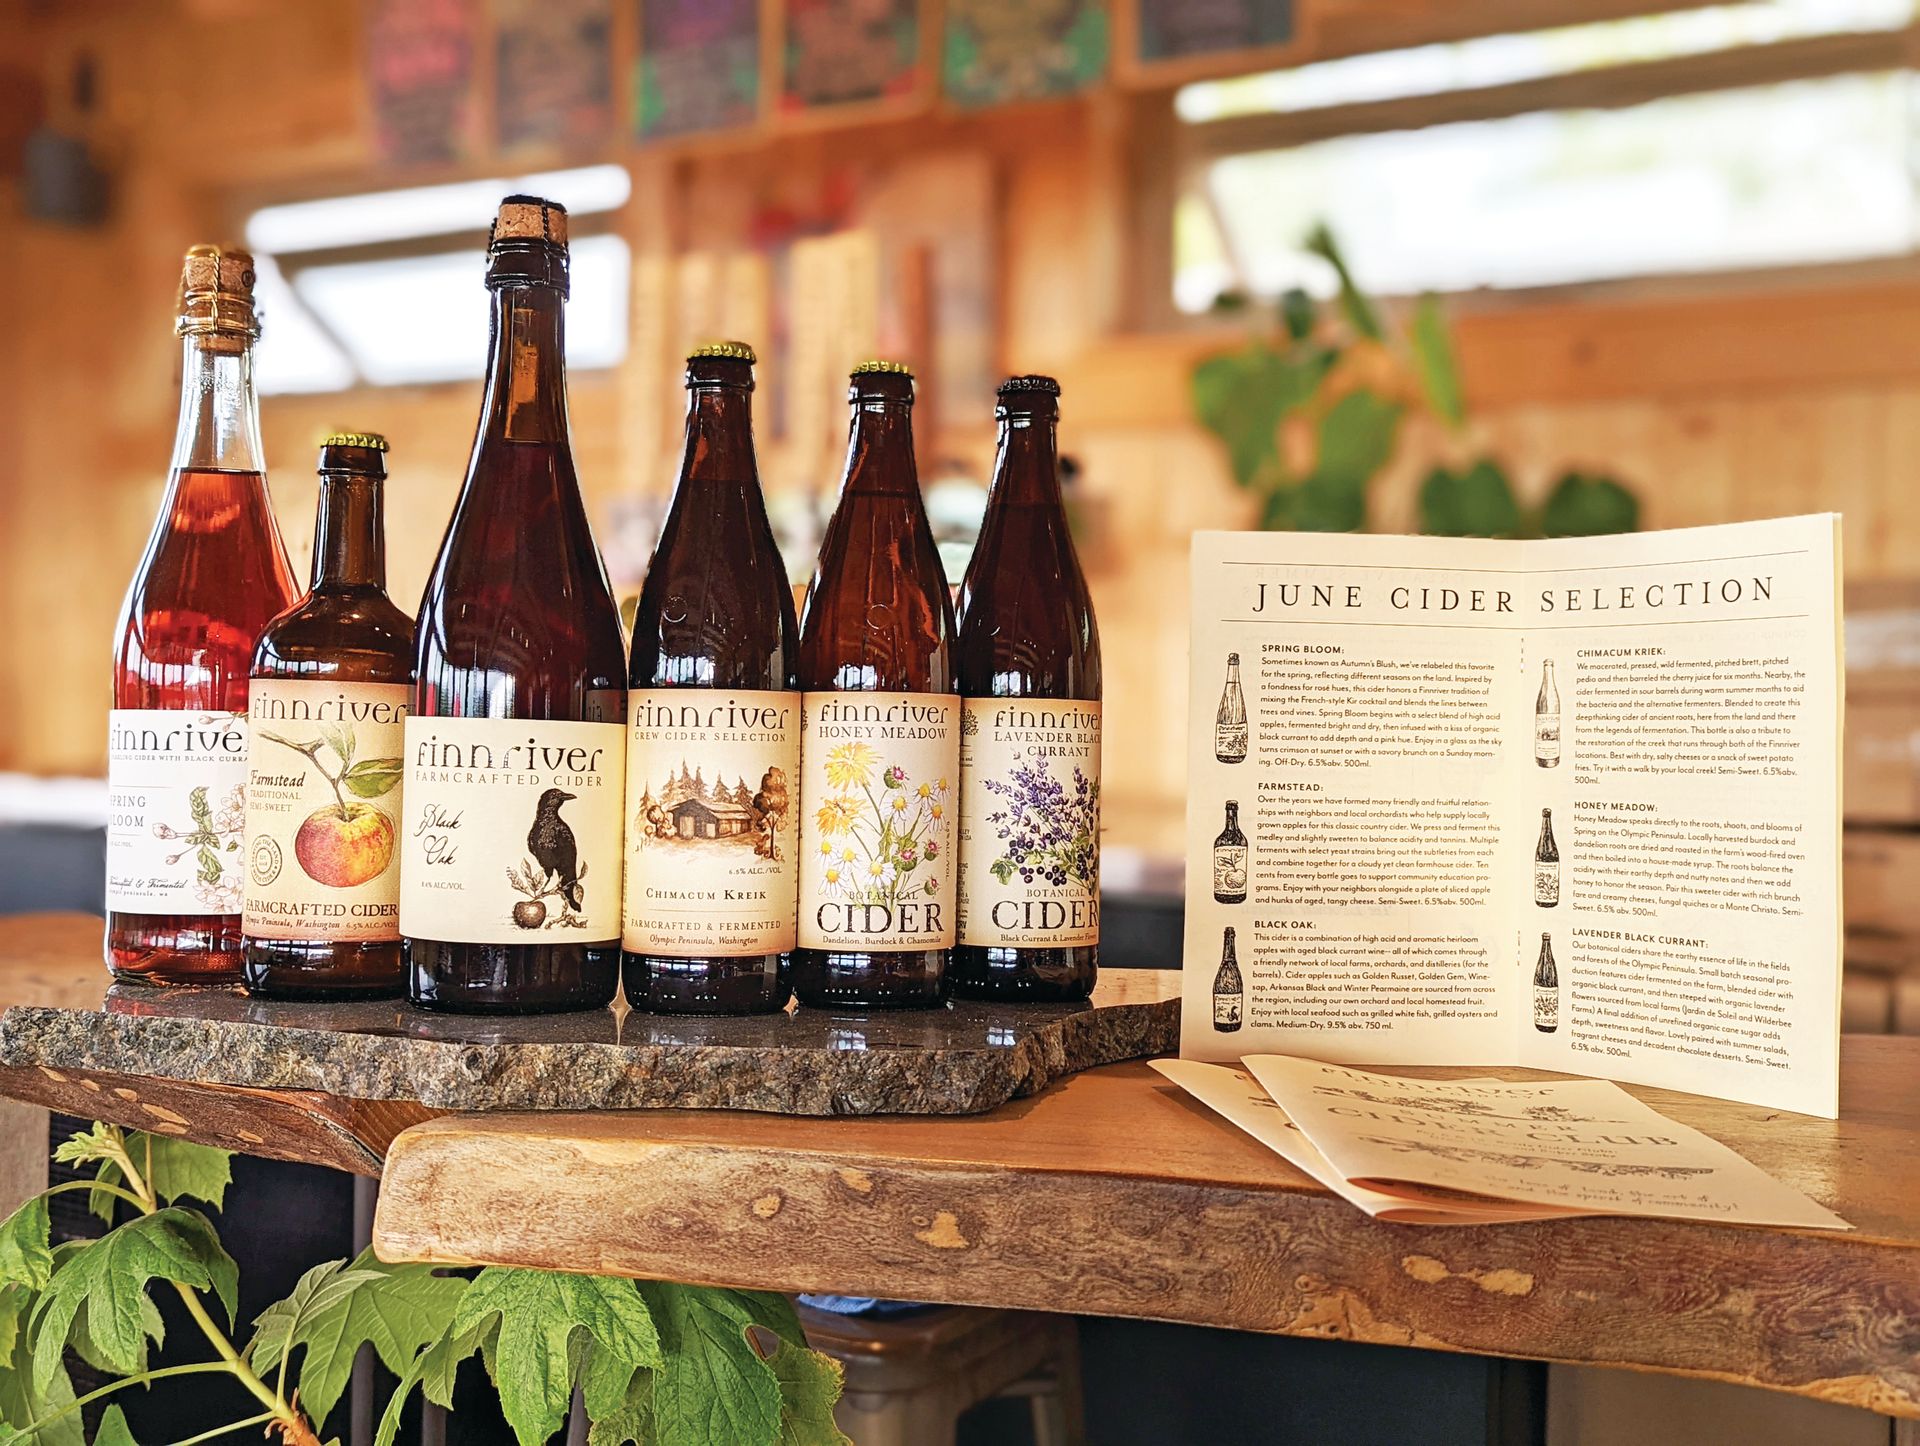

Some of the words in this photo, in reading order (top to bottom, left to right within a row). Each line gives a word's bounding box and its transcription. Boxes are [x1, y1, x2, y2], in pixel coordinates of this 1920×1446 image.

[1252, 583, 1364, 613] JUNE
[1391, 586, 1515, 613] CIDER
[1540, 576, 1775, 613] SELECTION
[1261, 644, 1299, 653] SPRING
[1303, 645, 1344, 653] BLOOM:
[1576, 648, 1631, 657] CHIMACUM
[1634, 647, 1665, 655] KRIEK:
[1576, 662, 1588, 670] We
[1659, 660, 1674, 668] wild
[1714, 658, 1740, 668] pitched
[1762, 656, 1788, 667] pitched
[253, 692, 409, 724] finnriver
[635, 699, 789, 730] finnriver
[819, 699, 949, 724] finnriver
[110, 723, 249, 753] finnrive
[634, 731, 660, 741] CREW
[664, 731, 707, 742] CIDER
[714, 732, 787, 743] SELECTION
[819, 726, 875, 738] HONEY
[880, 726, 948, 740] MEADOW
[994, 731, 1073, 743] LAVENDER
[416, 735, 604, 772] finnriver
[1027, 746, 1090, 757] CURRANT
[250, 769, 307, 788] Farmstead
[415, 770, 540, 786] FARMCRAFTED
[553, 775, 602, 787] CIDER
[1258, 782, 1323, 791] FARMSTEAD:
[250, 789, 302, 800] TRADITIONAL
[250, 802, 293, 813] SEMI-SWEET
[1574, 801, 1607, 810] HONEY
[1610, 802, 1657, 812] MEADOW:
[110, 813, 145, 827] LOOM
[413, 803, 464, 837] Black
[1573, 826, 1596, 837] Spring
[1597, 830, 1606, 838] on
[1608, 828, 1619, 836] the
[1620, 828, 1650, 839] Olympic
[1687, 832, 1712, 843] Locally
[1713, 833, 1748, 843] harvested
[1749, 835, 1779, 844] burdock
[1780, 837, 1795, 845] and
[423, 834, 459, 866] Oak
[645, 887, 716, 900] CHIMACUM
[724, 889, 768, 901] KREIK
[849, 890, 919, 901] BOTANICAL
[1026, 888, 1085, 898] BOTANICAL
[246, 898, 346, 917] FARMCRAFTED
[350, 903, 399, 917] CIDER
[1254, 895, 1270, 903] and
[1270, 895, 1293, 903] hunks
[1294, 895, 1303, 903] of
[1326, 898, 1348, 906] tangy
[816, 902, 945, 934] CIDER
[991, 900, 1098, 930] CIDER
[296, 919, 341, 931] Washington
[631, 918, 701, 931] FARMCRAFTED
[706, 922, 714, 931] &
[719, 920, 782, 931] FERMENTED
[1254, 920, 1287, 928] BLACK
[1290, 920, 1316, 928] OAK:
[649, 934, 676, 946] Olympic
[677, 935, 716, 946] Peninsula,
[718, 935, 759, 947] Washington
[822, 935, 863, 946] Dandelion,
[865, 936, 897, 946] Burdock
[899, 936, 905, 945] &
[906, 936, 942, 945] Chamomile
[1000, 934, 1020, 942] Black
[1023, 934, 1051, 942] Currant
[1052, 934, 1058, 942] &
[1059, 934, 1084, 942] Lavender
[1572, 927, 1621, 939] LAVENDER
[1624, 932, 1655, 942] BLACK
[1658, 935, 1708, 948] CURRANT:
[1571, 940, 1586, 949] Our
[1587, 941, 1620, 952] botanical
[1620, 945, 1641, 954] ciders
[1642, 947, 1661, 957] share
[1662, 949, 1674, 958] the
[1675, 952, 1697, 962] earthy
[1698, 956, 1726, 964] essence
[1727, 956, 1735, 965] of
[1735, 957, 1747, 966] life
[1748, 959, 1755, 967] in
[1757, 960, 1769, 969] the
[1770, 961, 1790, 971] fields
[1285, 970, 1306, 978] Cider
[1307, 971, 1332, 980] apples
[1333, 971, 1350, 979] such
[1361, 971, 1389, 979] Golden
[1418, 971, 1445, 980] Golden
[1467, 972, 1490, 980] Wine-
[1364, 1020, 1380, 1029] 750
[1327, 1107, 1506, 1137] CIDER
[1526, 1132, 1679, 1146] CLUB
